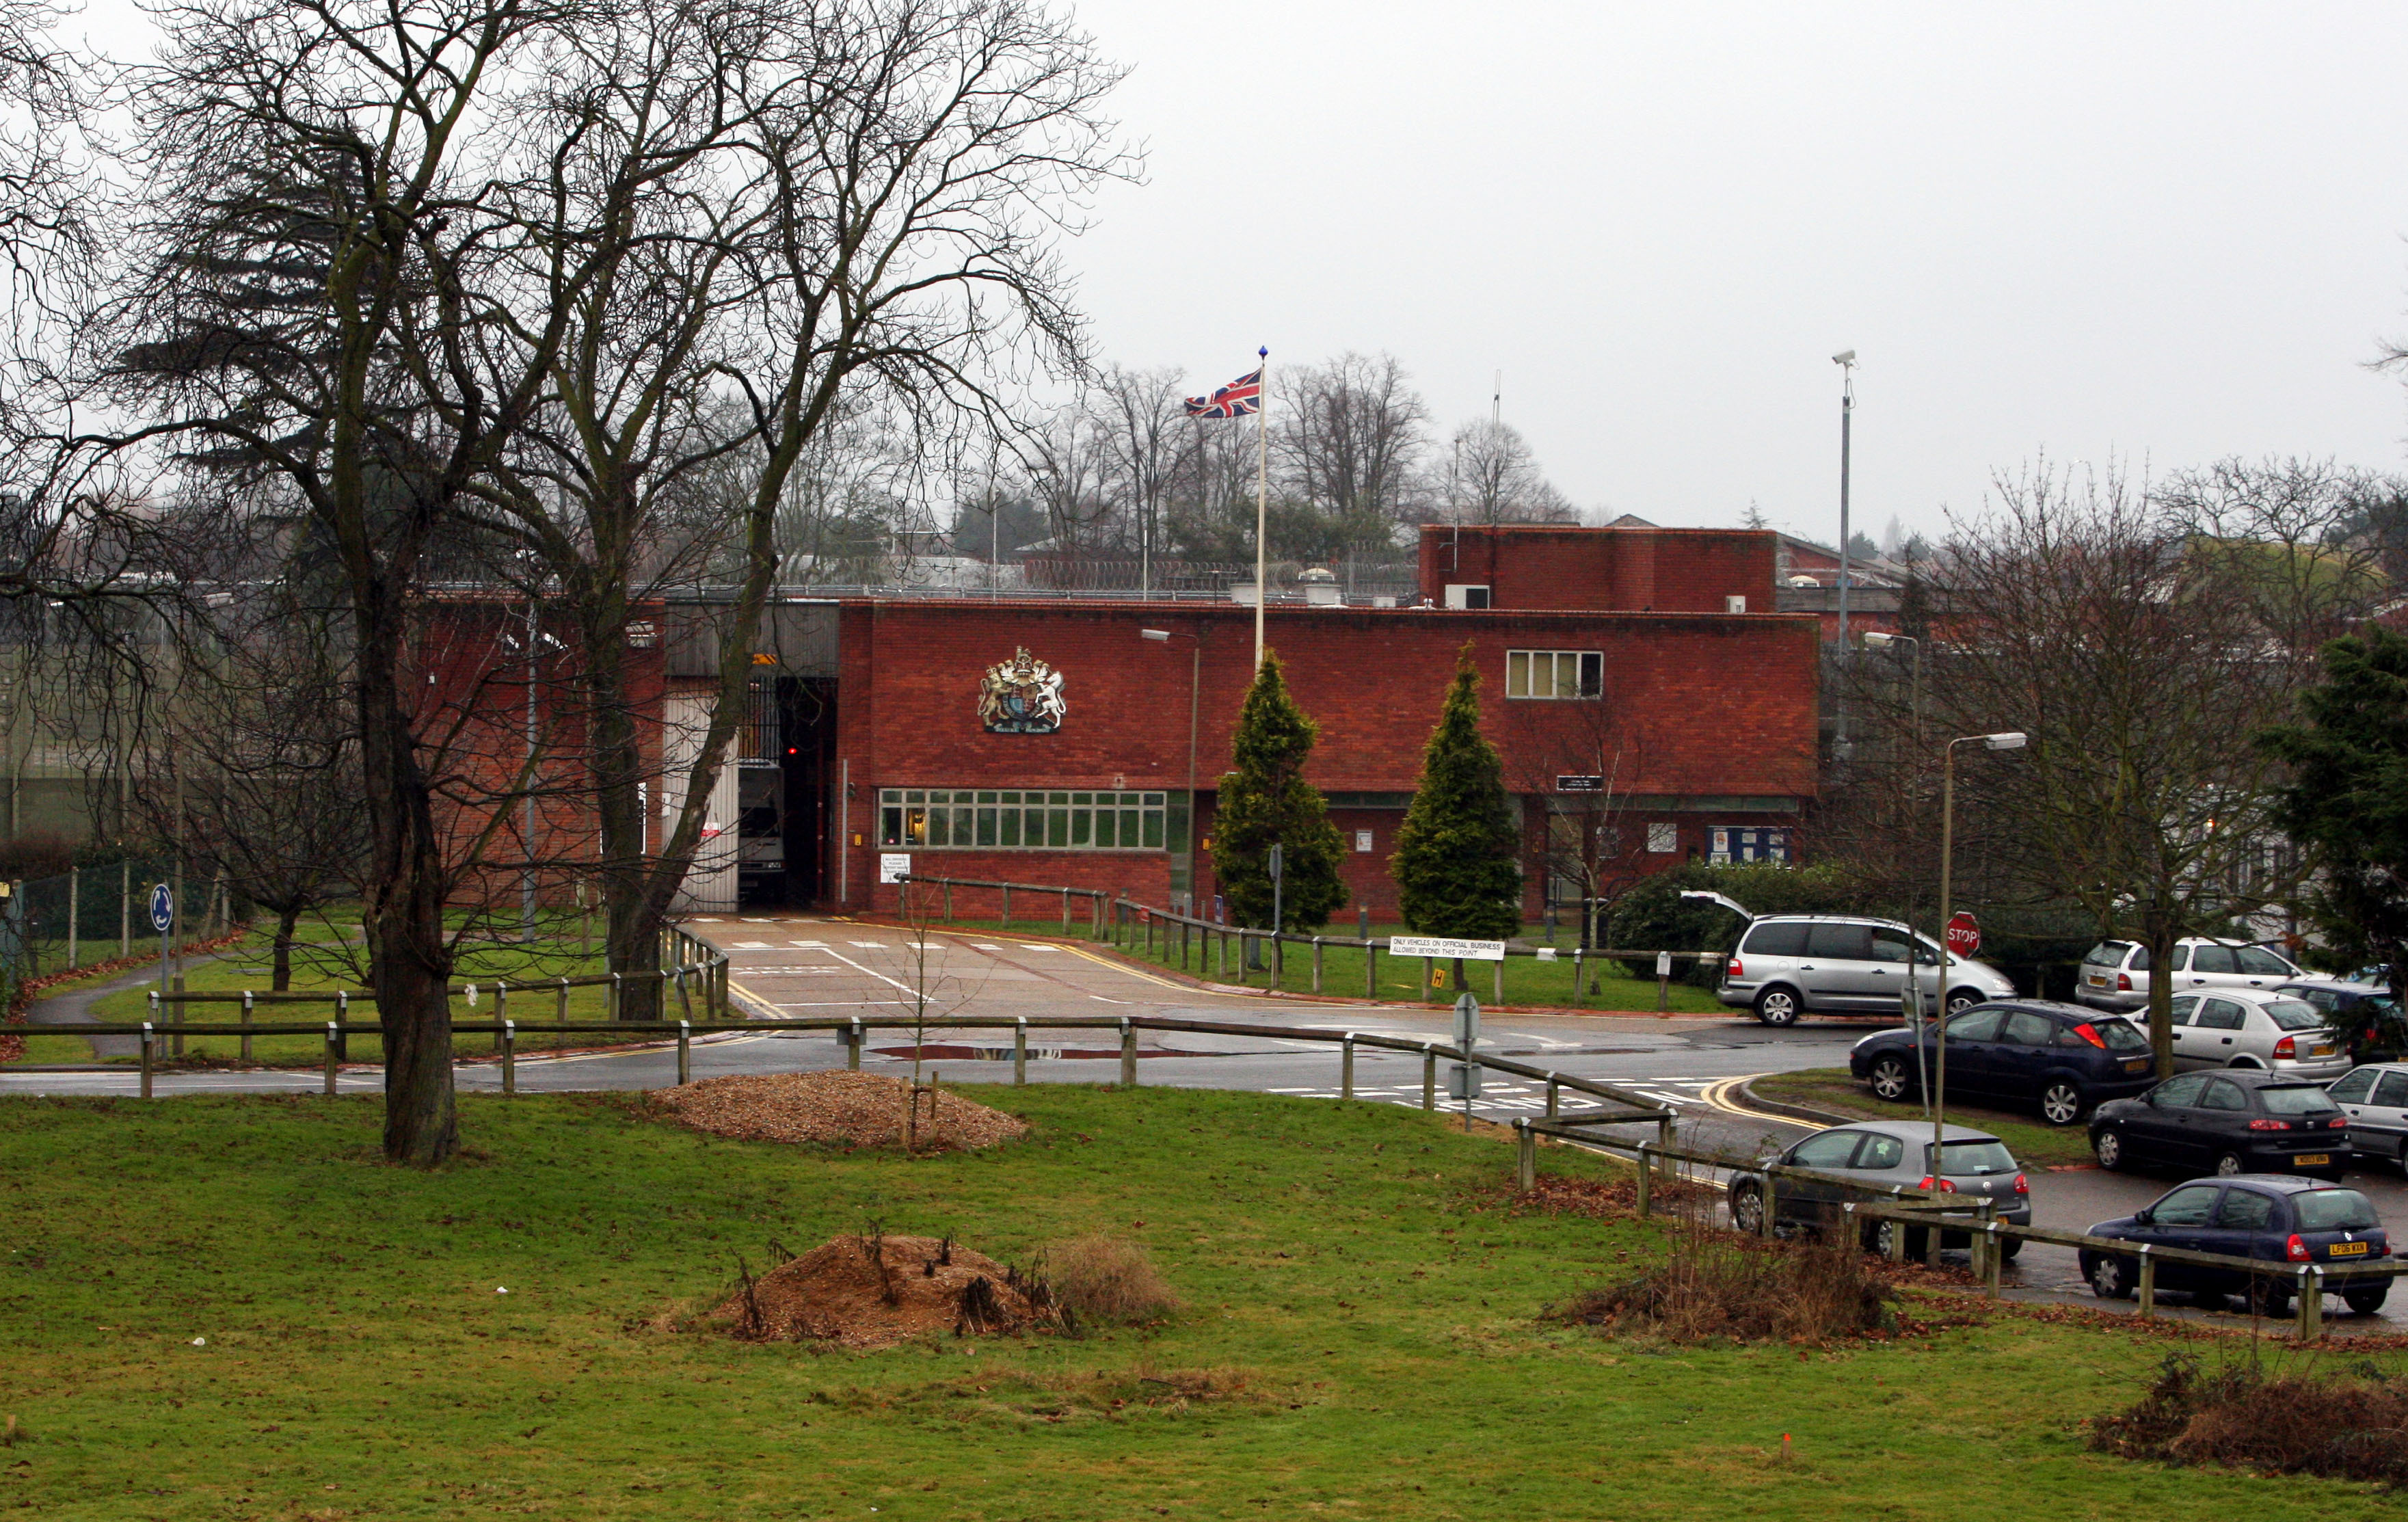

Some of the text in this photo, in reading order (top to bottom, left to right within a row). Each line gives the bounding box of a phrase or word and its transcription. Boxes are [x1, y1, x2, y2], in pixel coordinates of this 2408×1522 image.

[1948, 928, 1977, 943] STOP
[1443, 940, 1467, 948] OFFICIAL
[1471, 942, 1501, 950] BUSINESS
[1434, 972, 1443, 985] H
